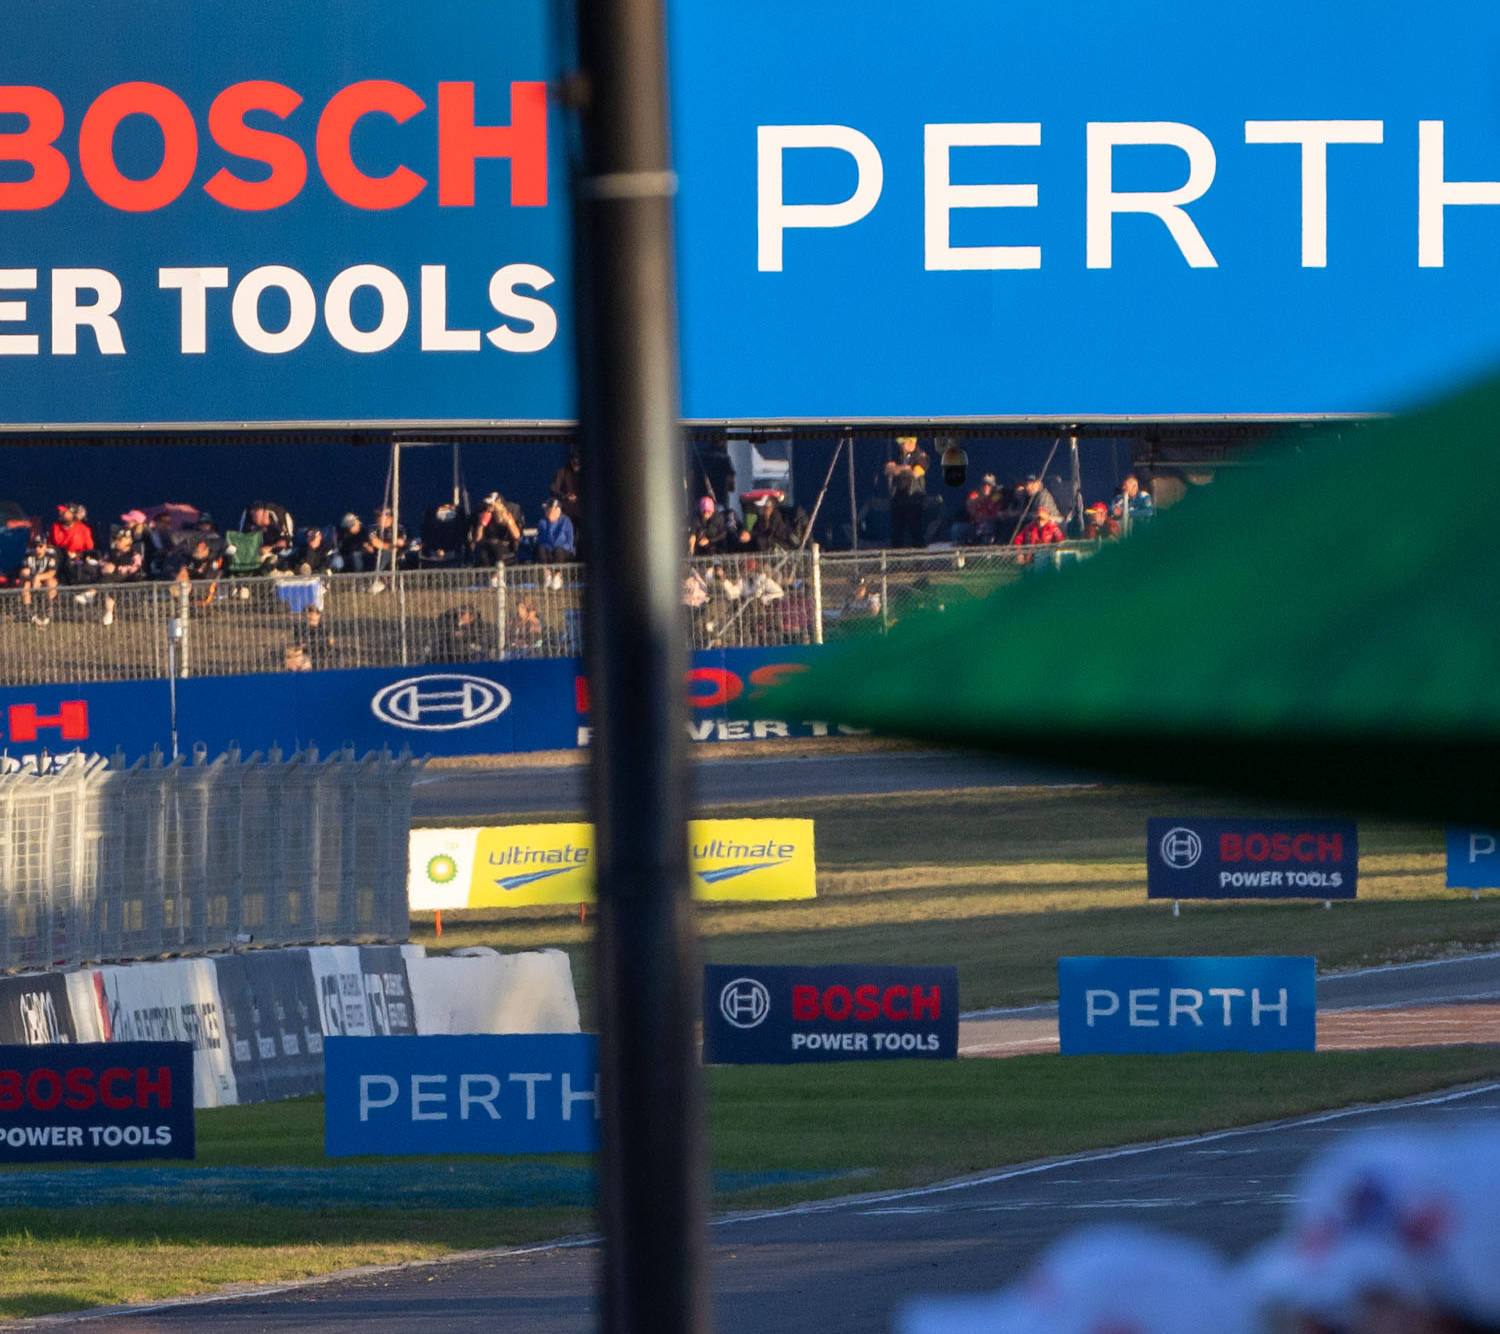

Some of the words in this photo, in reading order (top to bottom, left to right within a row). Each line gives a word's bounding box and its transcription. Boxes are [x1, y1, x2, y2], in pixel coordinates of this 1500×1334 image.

[160, 265, 558, 354] TOOLS
[489, 844, 589, 866] ultimate
[693, 839, 795, 860] ultimate
[1222, 835, 1342, 861] BOSCH
[1219, 869, 1283, 888] POWER
[1287, 869, 1343, 888] TOOLS
[794, 986, 941, 1021] BOSCH
[1088, 989, 1288, 1027] PERTH
[793, 1034, 869, 1051] POWER
[874, 1034, 940, 1051] TOOLS
[361, 1074, 599, 1122] PERTH
[90, 1127, 172, 1147] TOOLS
